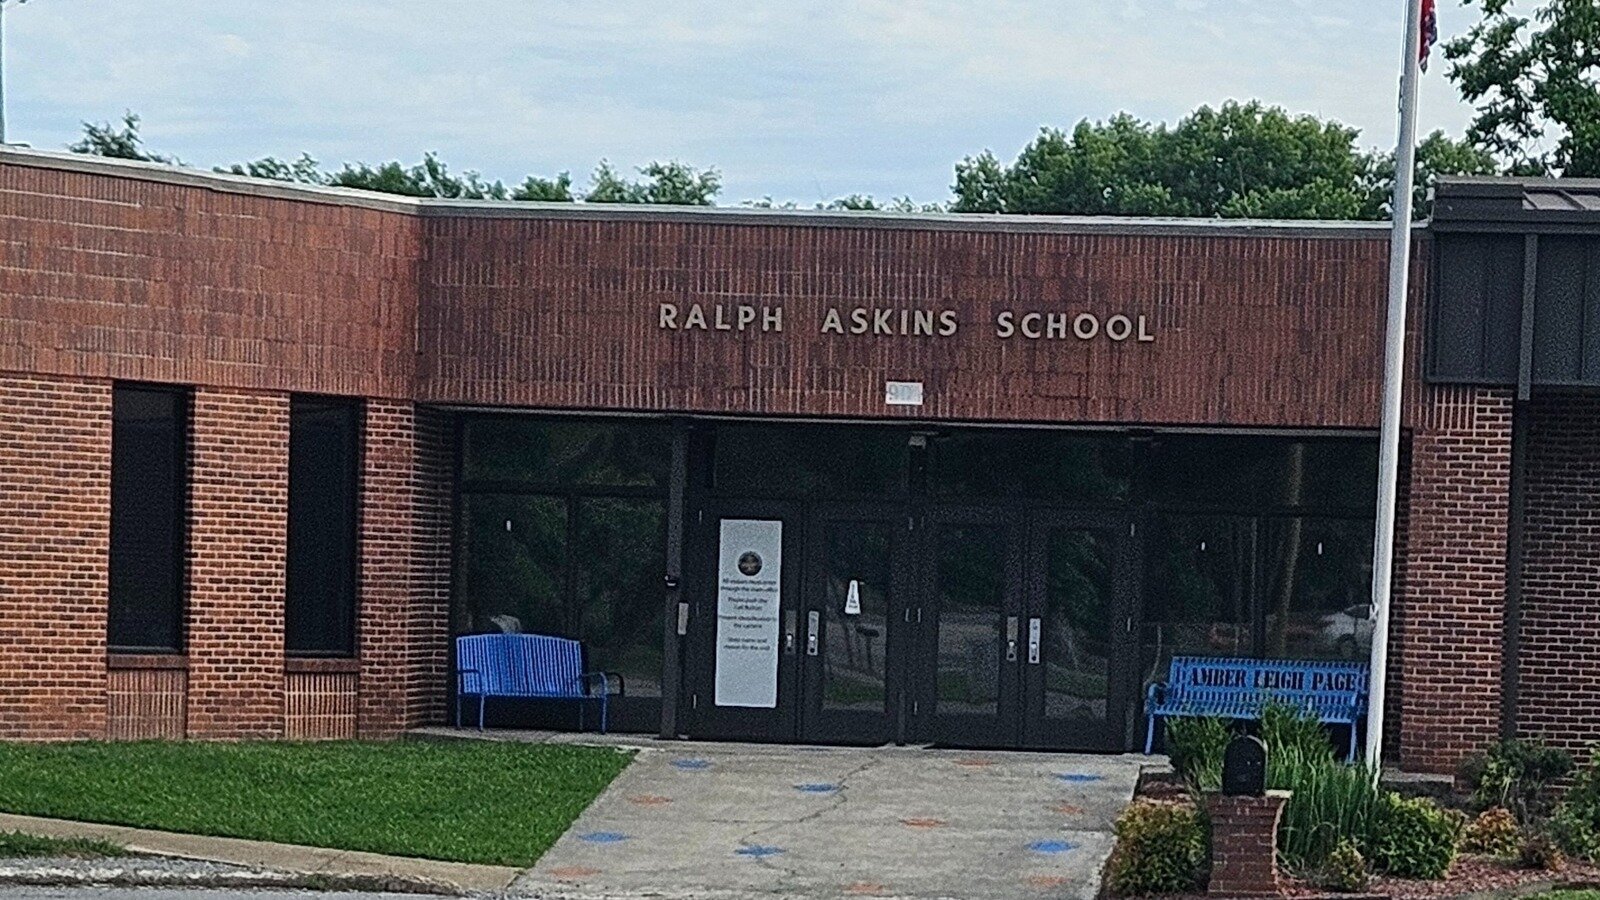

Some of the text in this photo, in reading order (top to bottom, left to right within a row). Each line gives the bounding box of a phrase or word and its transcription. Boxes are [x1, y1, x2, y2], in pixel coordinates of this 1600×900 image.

[659, 303, 1155, 342] RALPH ASKINS SCHOOL
[1190, 667, 1358, 691] AMBER LEIGH PAGE
